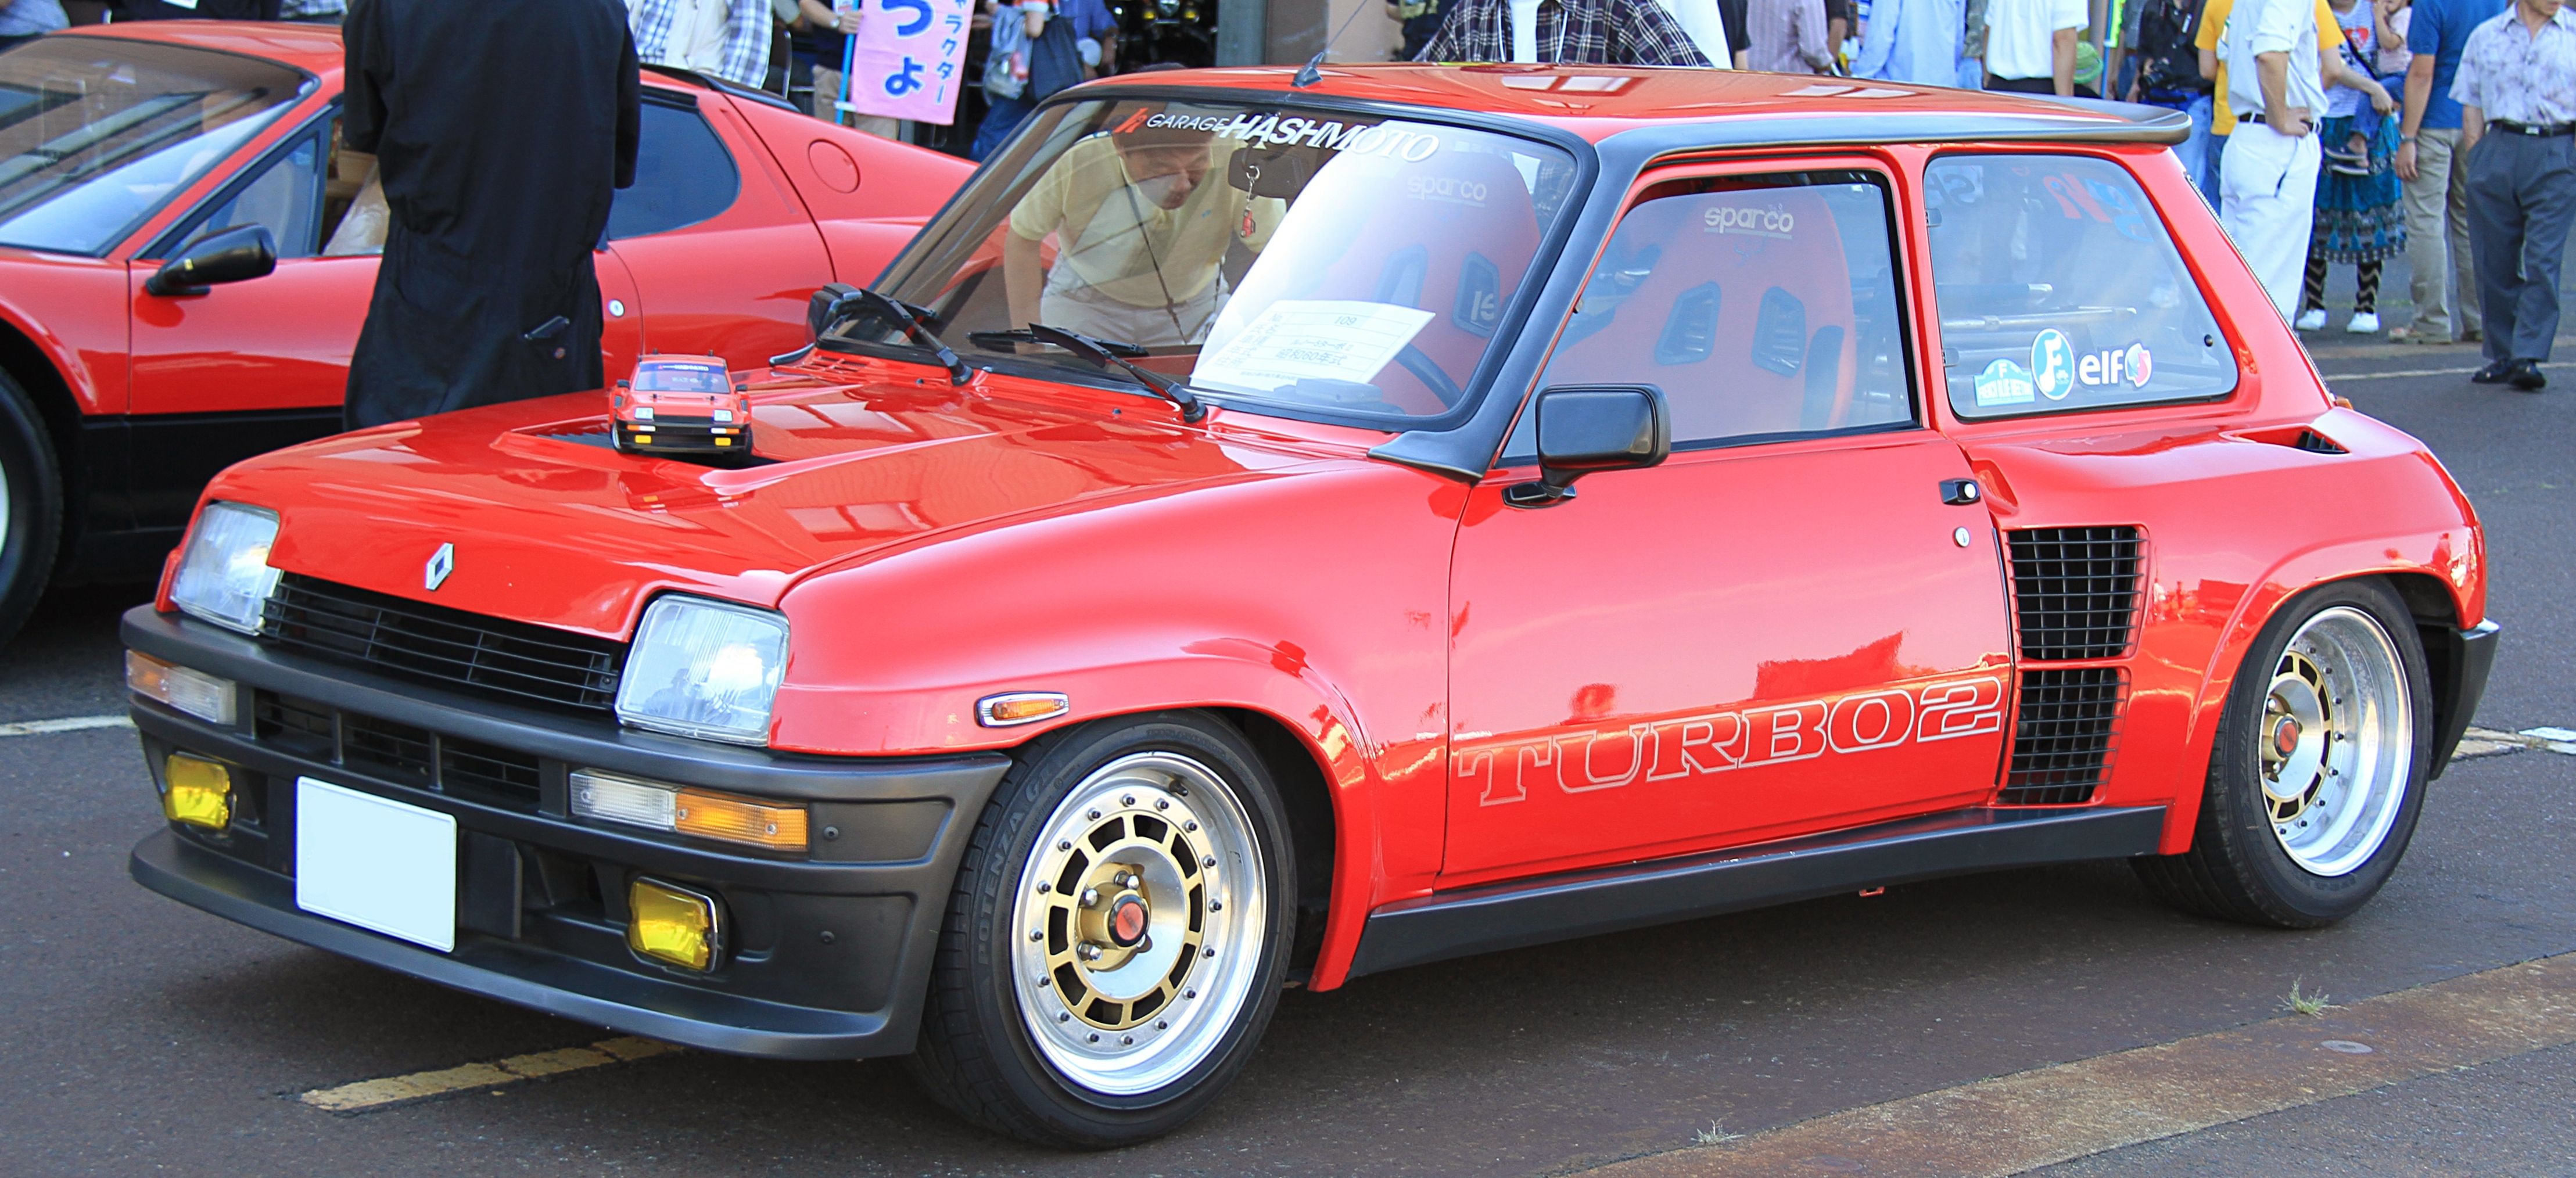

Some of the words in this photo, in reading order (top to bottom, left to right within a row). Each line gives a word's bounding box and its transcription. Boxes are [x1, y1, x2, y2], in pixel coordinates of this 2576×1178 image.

[1146, 113, 1229, 132] GARAGE
[1407, 175, 1487, 202] sparco
[1704, 206, 1794, 234] sparco
[1334, 315, 1358, 326] 109
[1275, 348, 1348, 367] 昭和60年式
[1998, 362, 2008, 379] F
[2079, 349, 2124, 386] elf
[1457, 675, 2003, 808] TURBO2
[978, 810, 1027, 966] POTENZA
